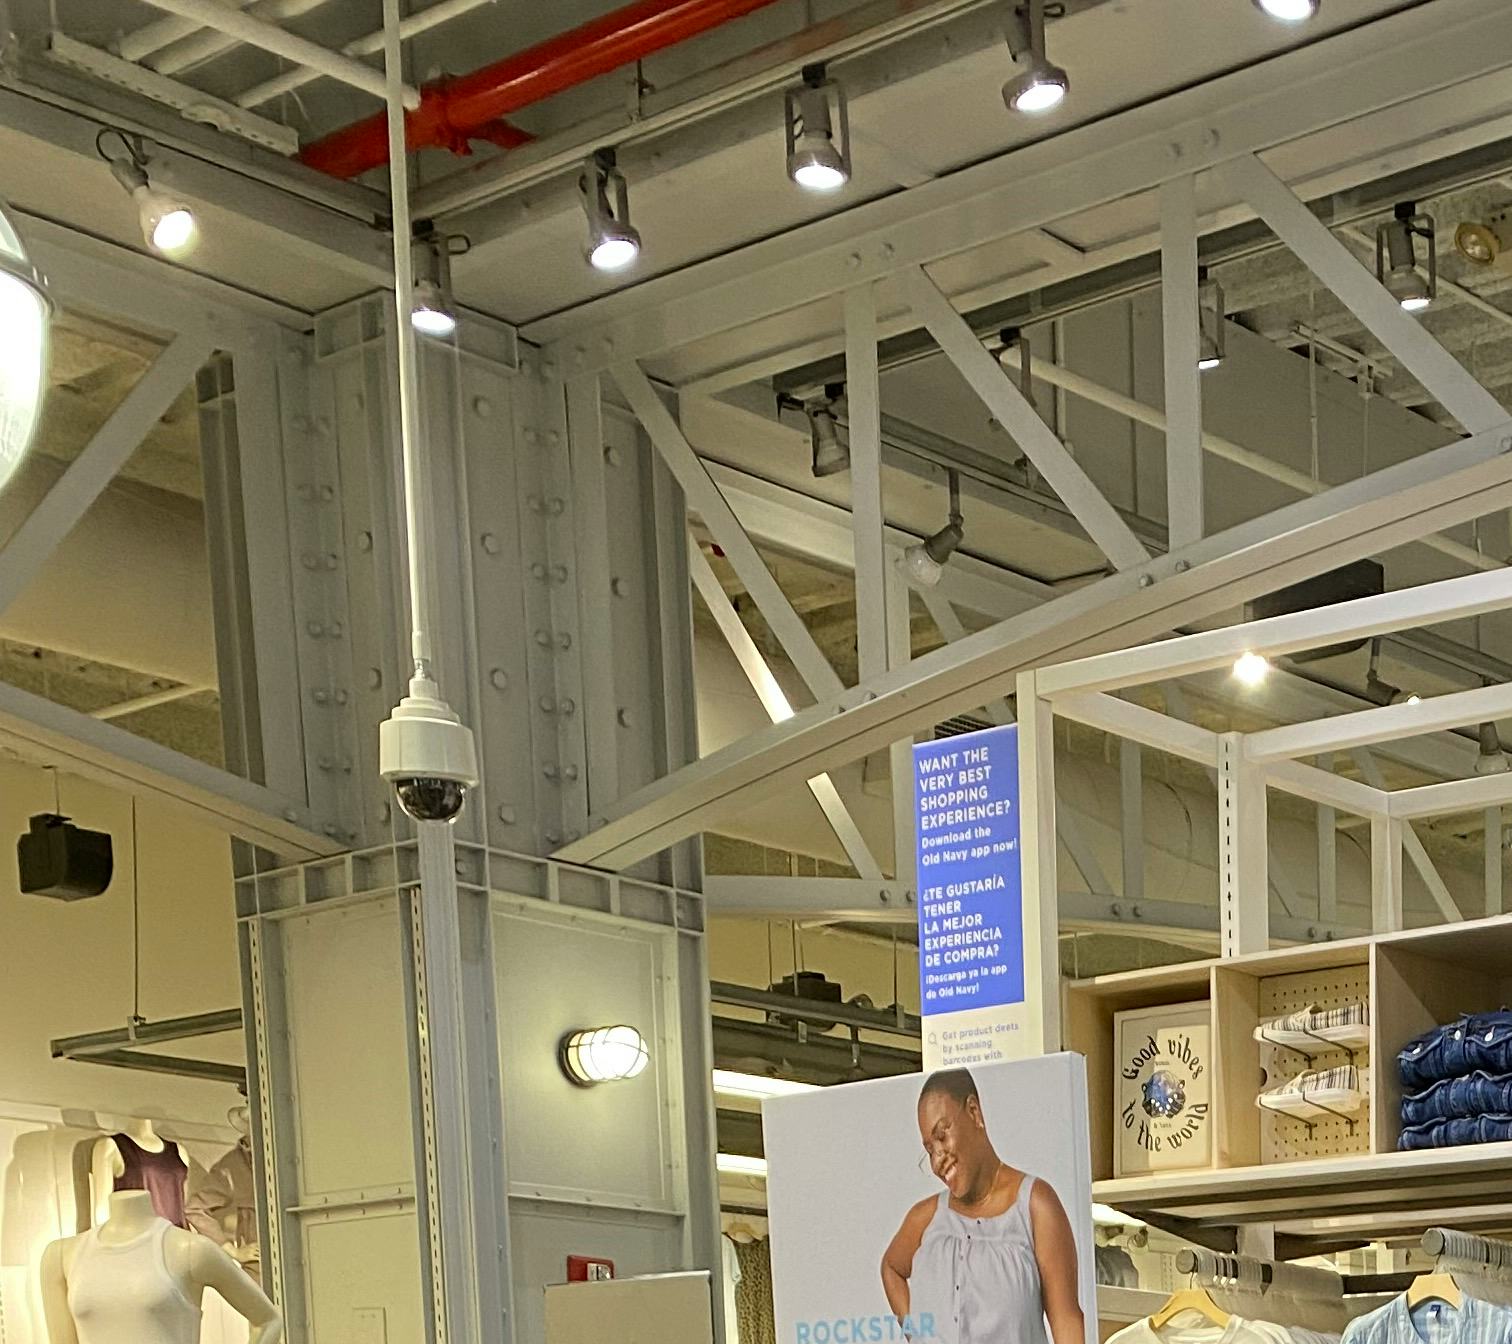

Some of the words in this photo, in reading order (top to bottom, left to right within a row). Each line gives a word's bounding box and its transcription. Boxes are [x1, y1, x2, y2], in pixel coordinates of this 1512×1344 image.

[919, 754, 958, 774] WANT
[963, 747, 988, 764] THE
[920, 773, 954, 792] VERY
[959, 766, 991, 785] BEST
[921, 785, 987, 811] SHOPPING
[921, 799, 1010, 830] EXPERIENCE?
[922, 828, 971, 849] Download
[975, 826, 991, 838] the
[922, 853, 939, 866] Old
[943, 849, 967, 862] Navy
[971, 846, 990, 858] app
[923, 887, 942, 902] ¿TE
[946, 874, 1005, 897] GUSTARÍA
[924, 900, 961, 917] TENER
[924, 921, 939, 934] LA
[943, 914, 982, 931] MEJOR
[925, 926, 1002, 951] EXPERIENCIA
[925, 954, 940, 967] DE
[944, 944, 1000, 964] COMPRA?
[969, 969, 978, 979] ya
[991, 965, 1007, 974] app
[939, 987, 953, 997] Old
[1122, 1035, 1161, 1080] Good
[1168, 1034, 1203, 1080] vibes
[1122, 1099, 1136, 1128] to
[1138, 1120, 1161, 1152] the
[1168, 1103, 1208, 1149] world
